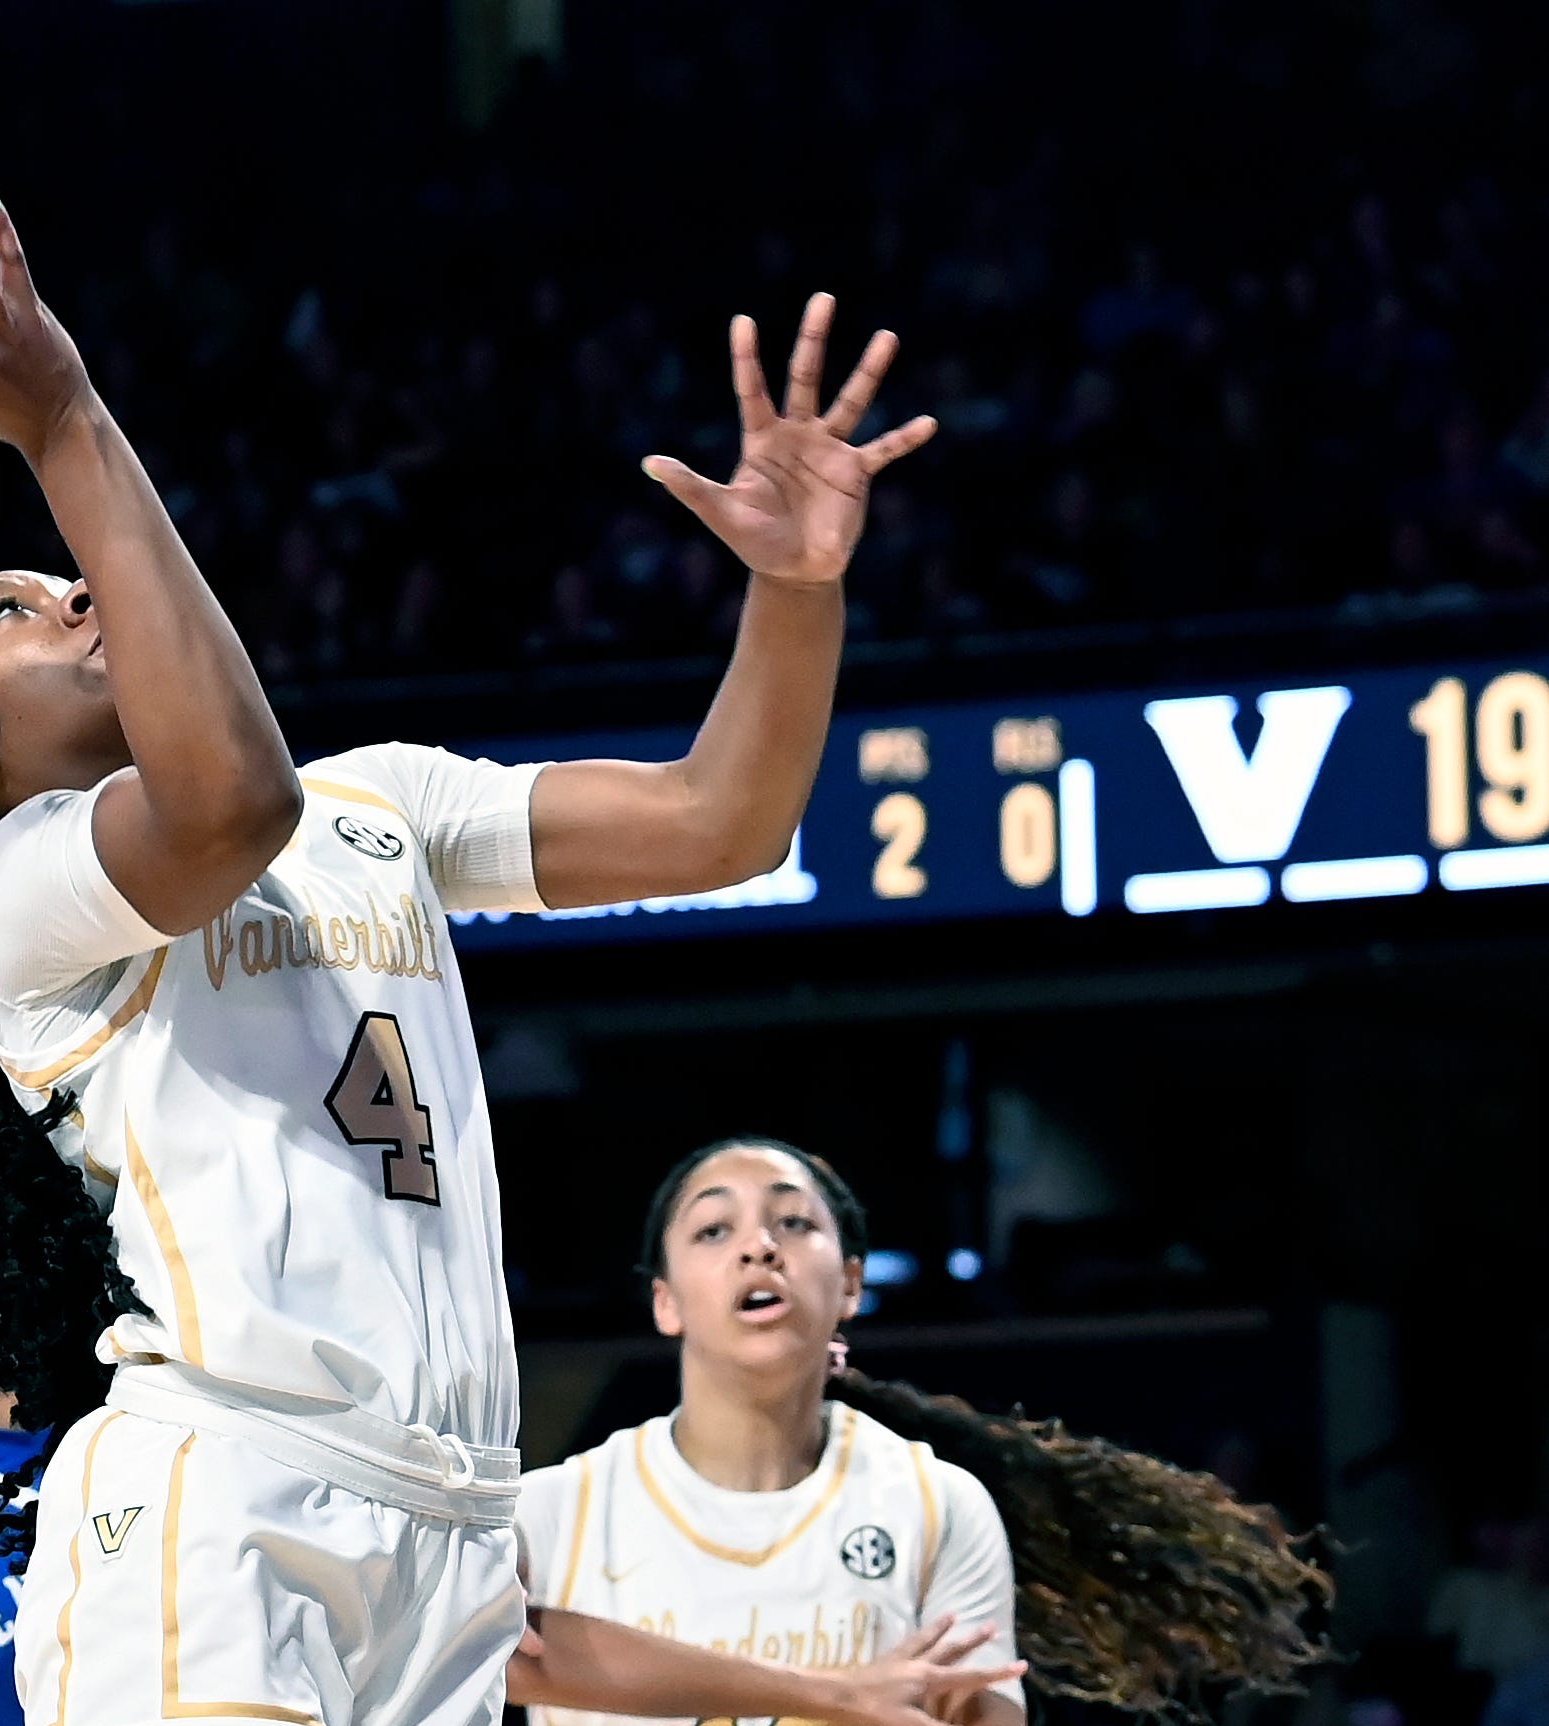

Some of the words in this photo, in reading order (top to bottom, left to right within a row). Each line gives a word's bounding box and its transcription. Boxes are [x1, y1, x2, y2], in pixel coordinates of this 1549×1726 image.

[1143, 685, 1353, 864] V
[1408, 671, 1549, 850] 19
[871, 791, 929, 900] 2
[998, 782, 1057, 889] 0
[203, 884, 445, 993] Vanderbilt
[323, 1011, 442, 1207] 4
[92, 1505, 147, 1555] V
[637, 1599, 884, 1670] derbilt
